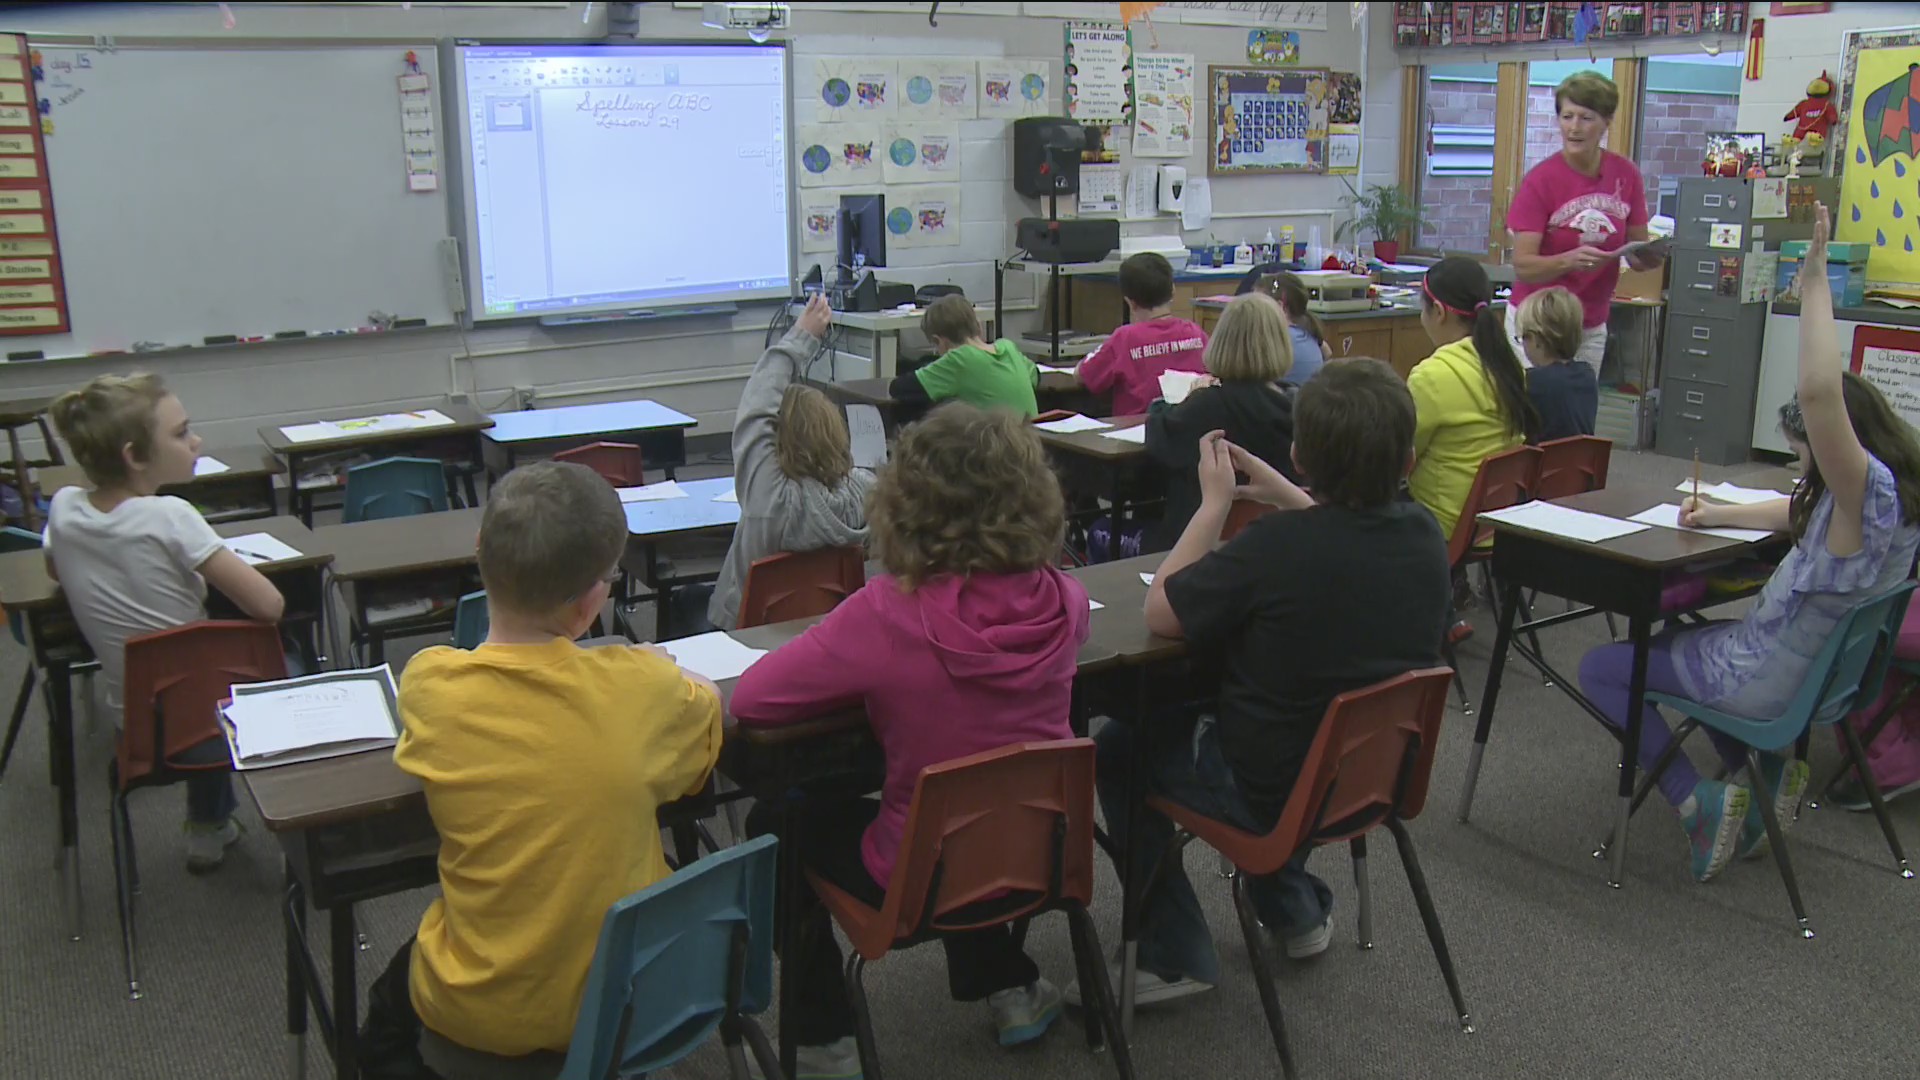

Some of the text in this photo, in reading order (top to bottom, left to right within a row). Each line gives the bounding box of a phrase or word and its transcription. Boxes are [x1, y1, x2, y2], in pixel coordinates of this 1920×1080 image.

[1071, 31, 1125, 42] LET'S GET ALONG
[576, 91, 713, 119] Spelling ABC
[596, 113, 680, 131] Lesson 29
[1130, 347, 1143, 361] WE
[1143, 342, 1170, 358] BELIEVE
[1171, 340, 1179, 353] IN
[1867, 363, 1889, 374] Respect
[1890, 367, 1908, 376] others
[1877, 377, 1891, 385] kind
